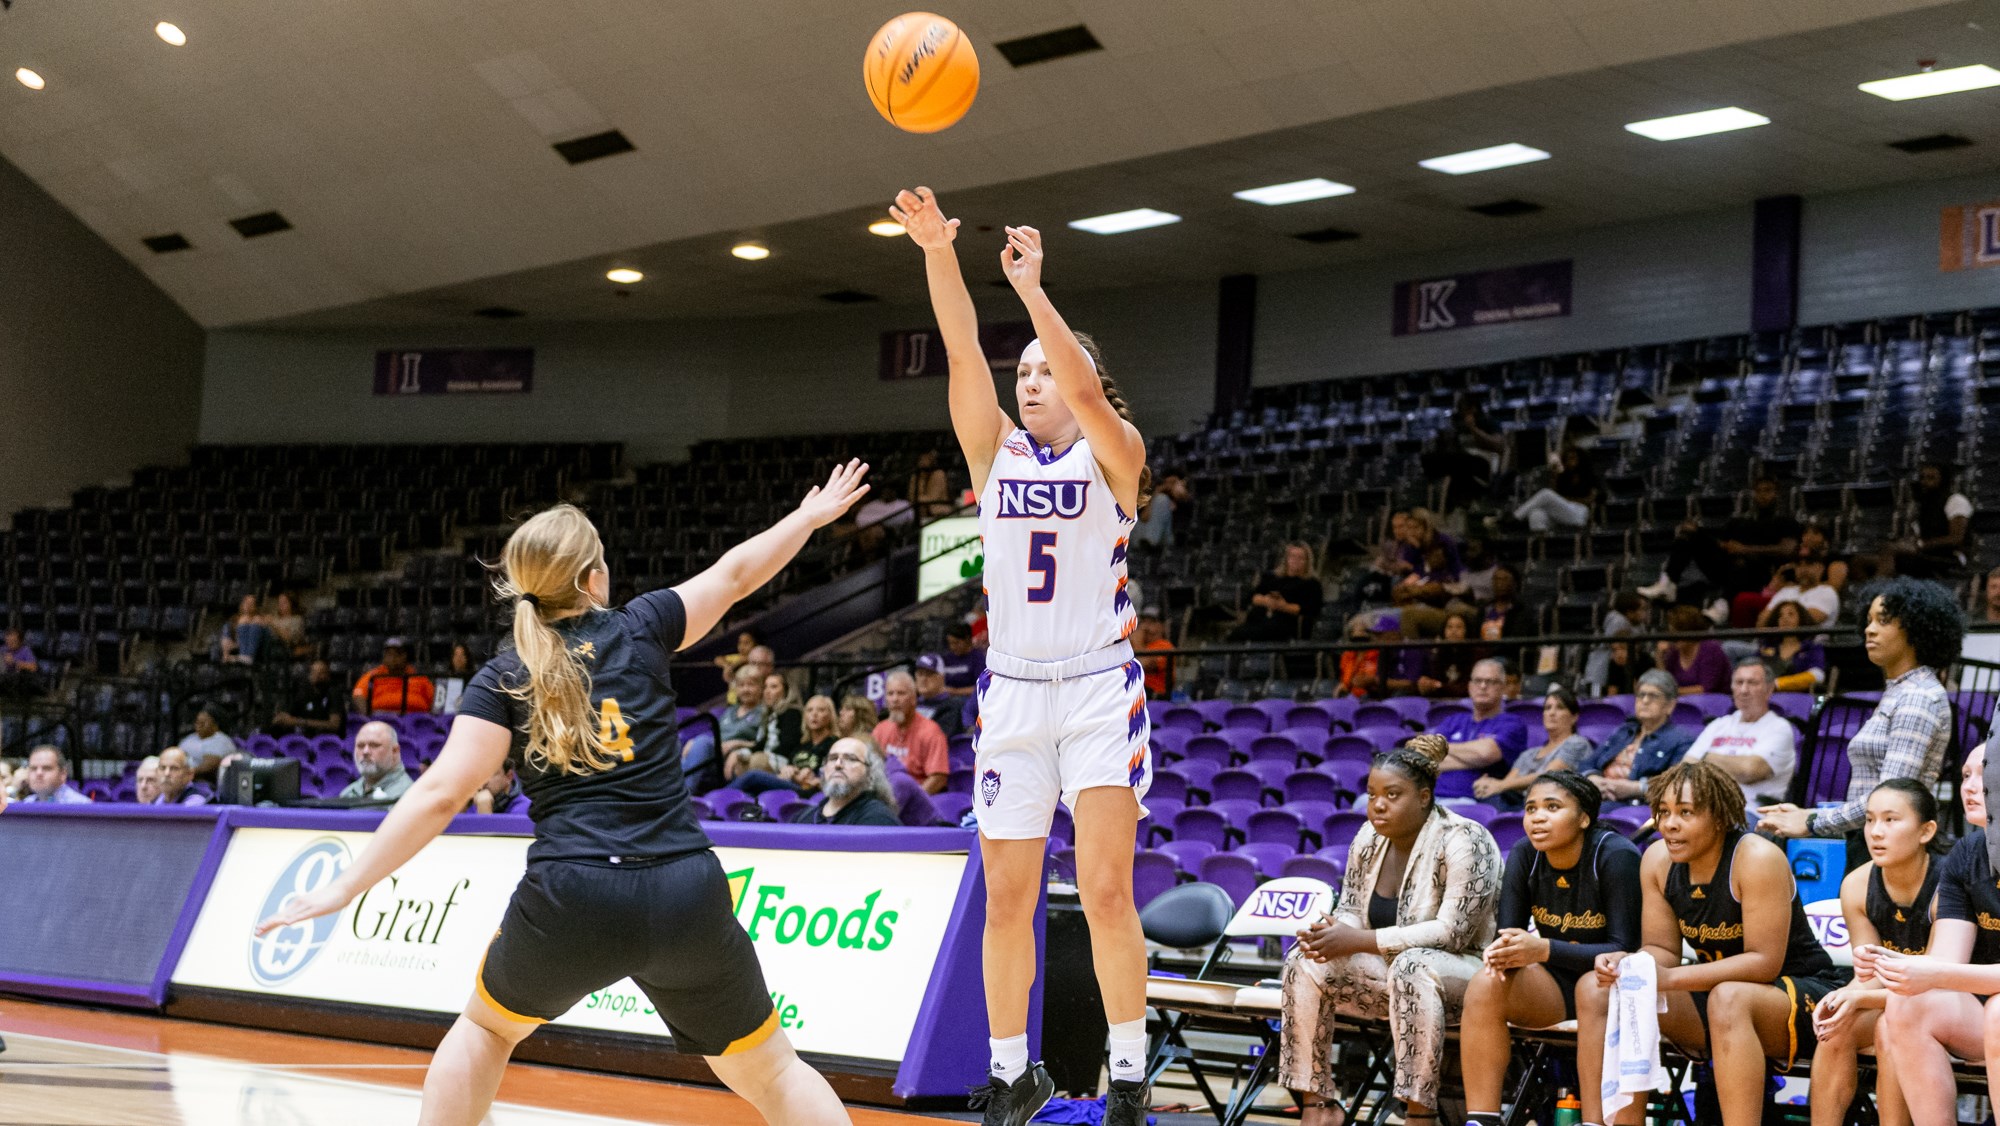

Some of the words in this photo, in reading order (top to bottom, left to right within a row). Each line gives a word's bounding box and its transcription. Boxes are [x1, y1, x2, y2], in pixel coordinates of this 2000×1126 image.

[1418, 280, 1457, 330] K
[905, 333, 928, 375] J
[997, 479, 1091, 520] NSU
[1027, 530, 1058, 604] 5
[866, 673, 885, 700] B
[352, 874, 470, 946] Graf
[749, 885, 899, 951] Foods
[1250, 890, 1320, 919] NSU
[1560, 909, 1606, 933] Jackets
[1806, 915, 1850, 946] NS
[337, 947, 440, 972] orthodontics
[586, 988, 638, 1018] Shop.
